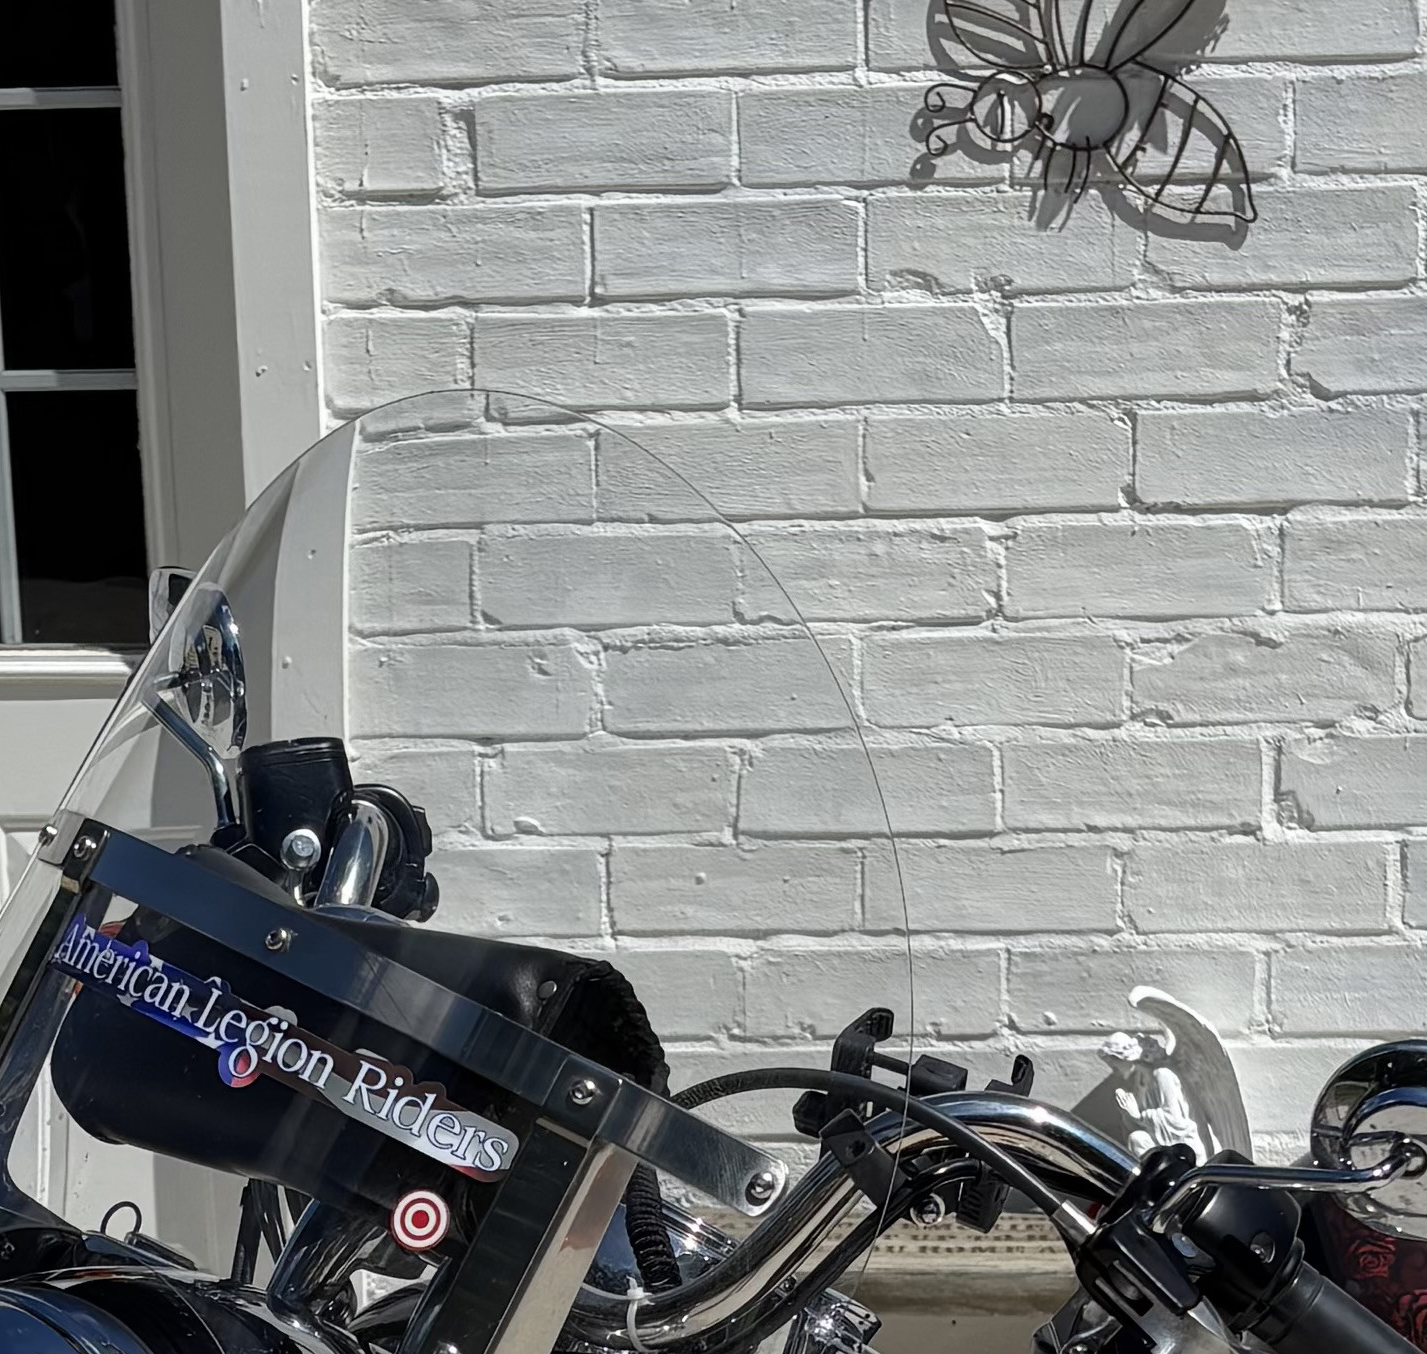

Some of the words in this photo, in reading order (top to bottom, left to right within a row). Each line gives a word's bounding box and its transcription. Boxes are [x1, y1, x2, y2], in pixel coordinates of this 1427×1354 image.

[54, 925, 191, 1018] American
[194, 986, 335, 1090] Legion
[343, 1057, 511, 1173] Riders
